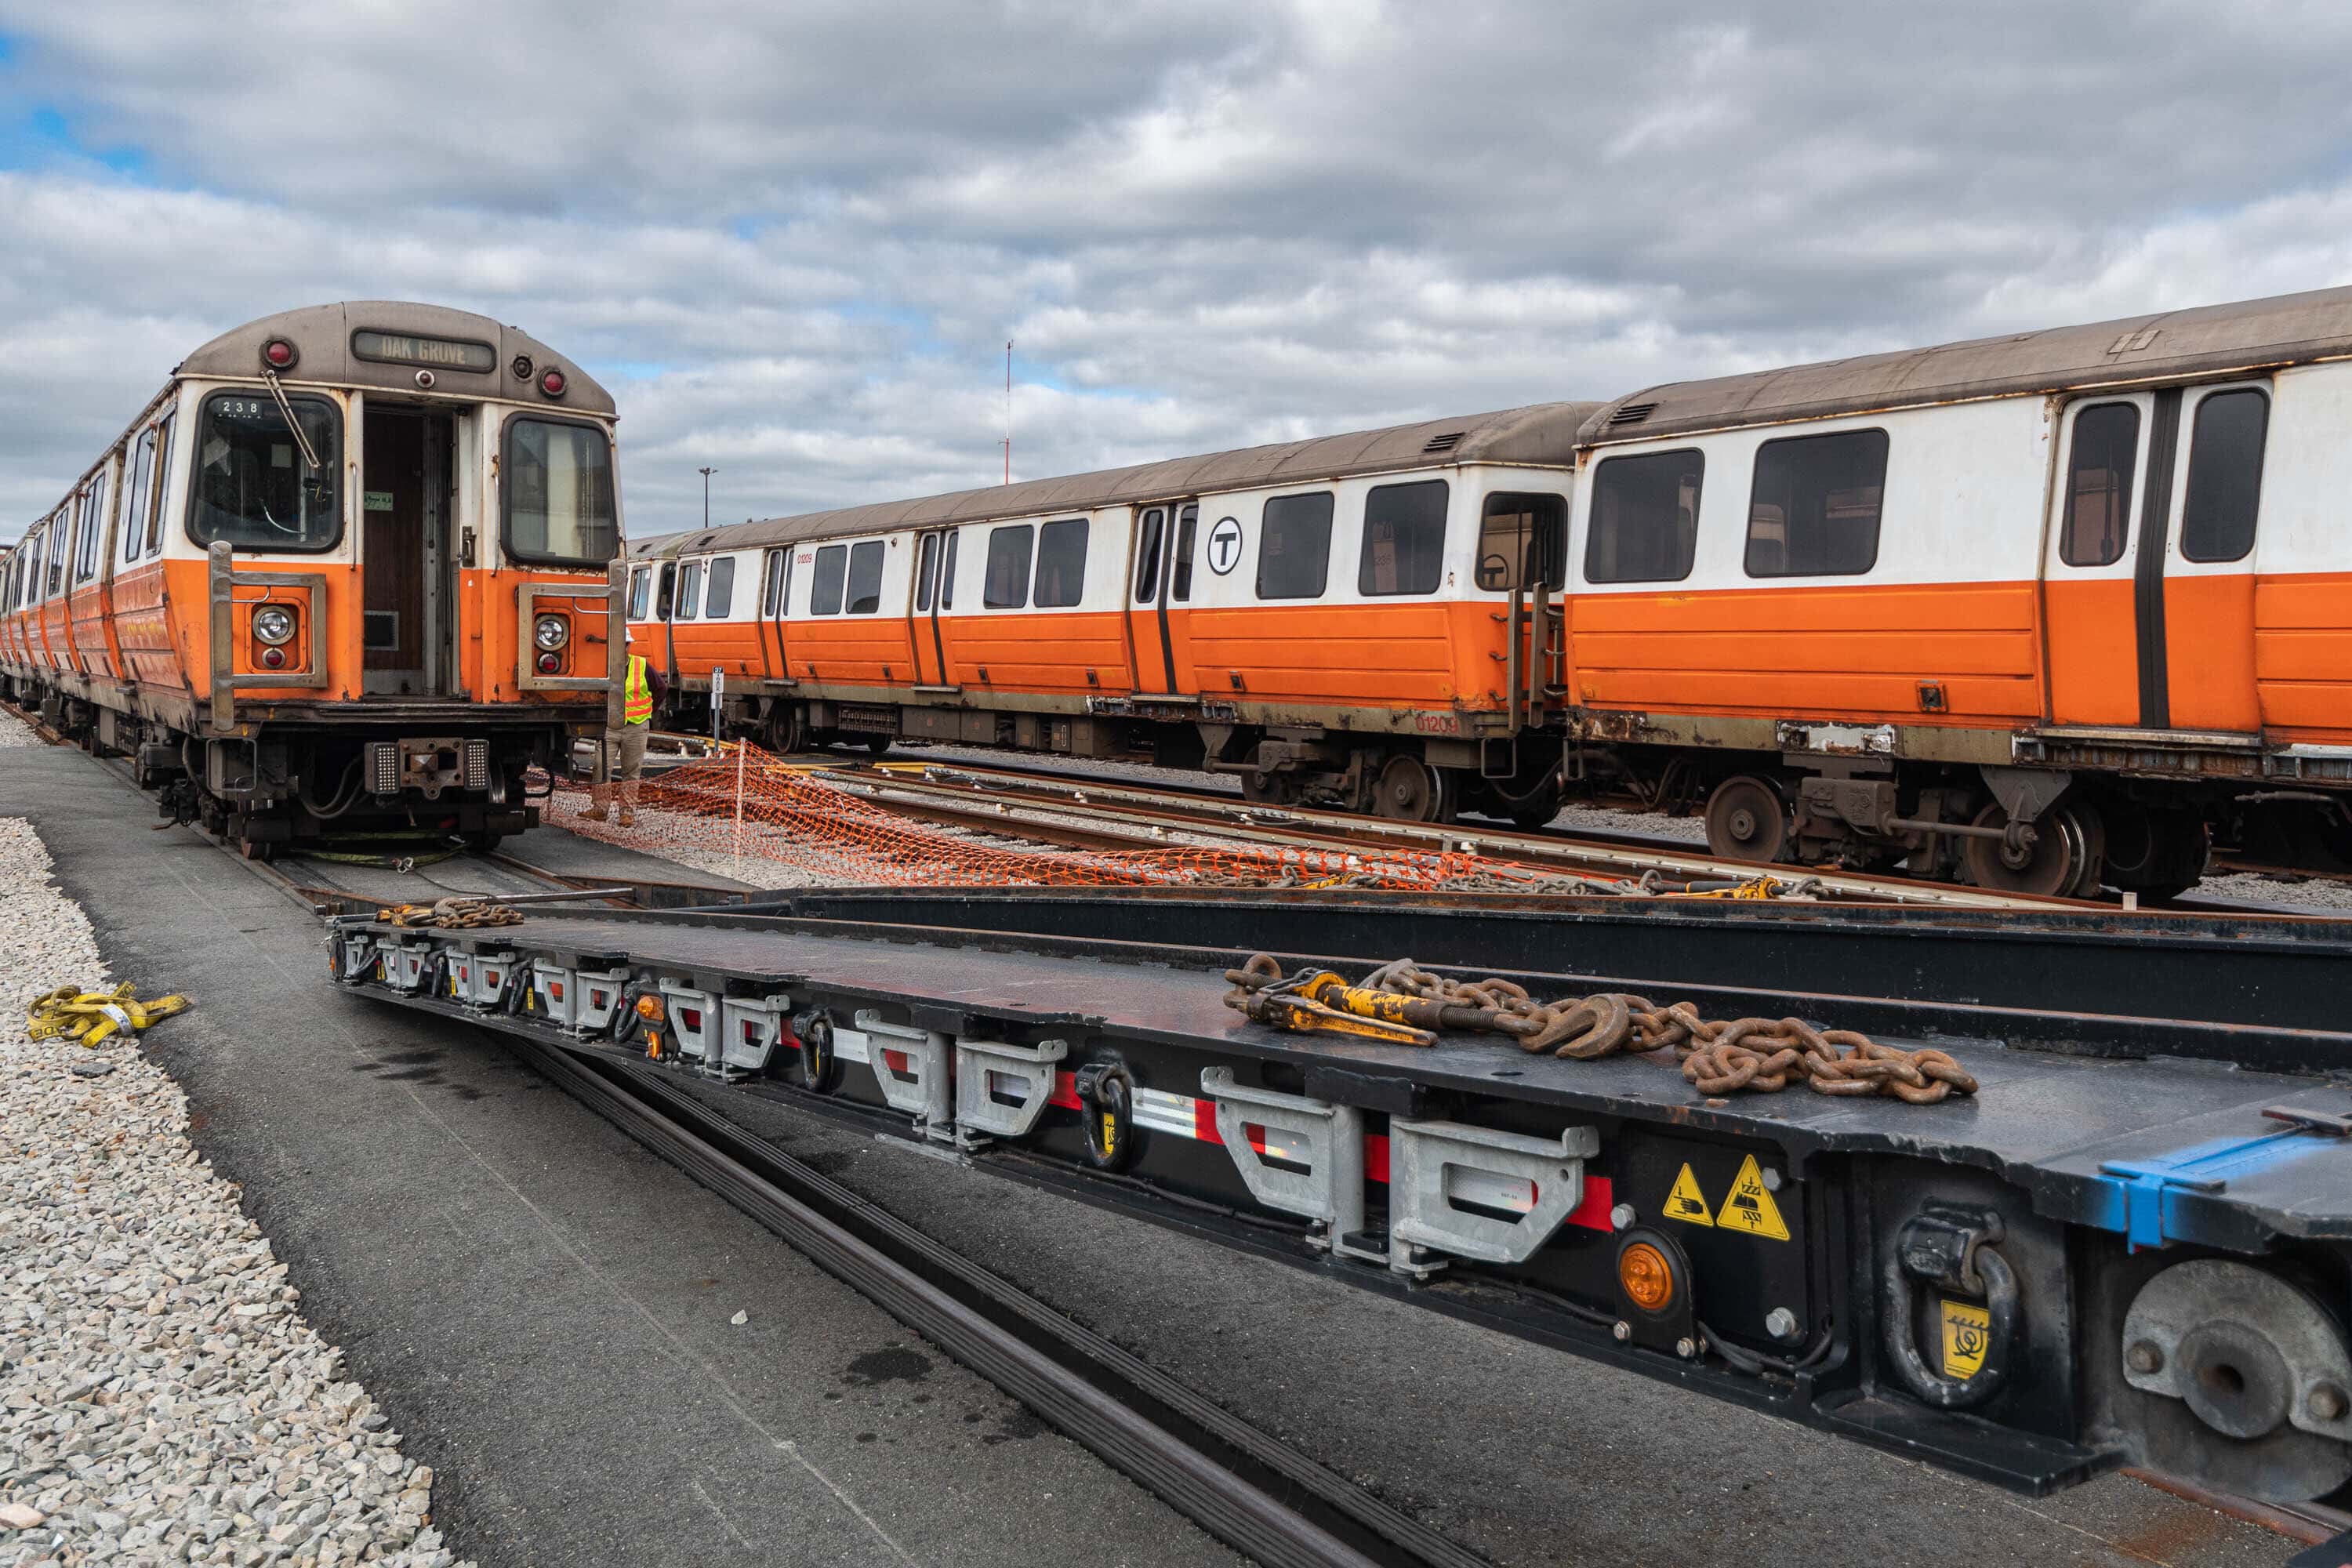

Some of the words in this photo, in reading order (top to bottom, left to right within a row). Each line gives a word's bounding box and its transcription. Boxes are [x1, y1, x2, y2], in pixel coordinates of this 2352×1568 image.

[382, 337, 412, 359] OAK
[419, 340, 466, 365] GROVE
[797, 553, 812, 564] 01209
[1215, 532, 1236, 566] T
[1415, 715, 1458, 733] 01209
